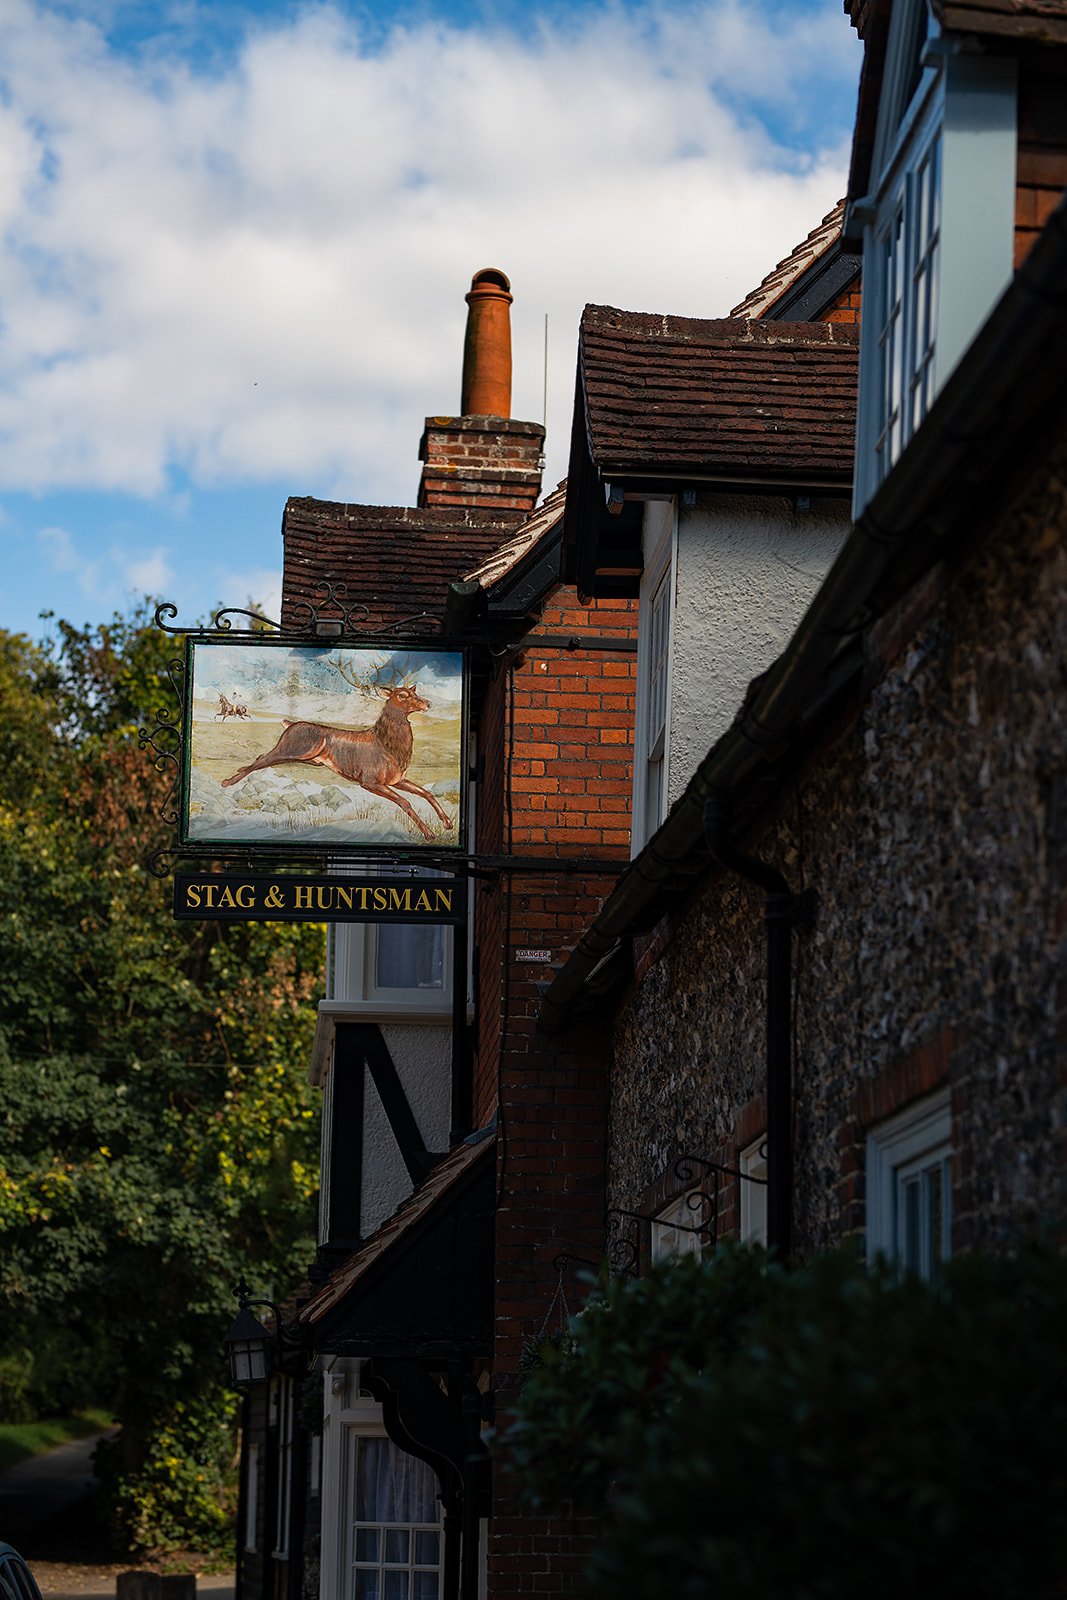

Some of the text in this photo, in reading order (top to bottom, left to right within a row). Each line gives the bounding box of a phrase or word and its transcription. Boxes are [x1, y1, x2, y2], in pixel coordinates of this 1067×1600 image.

[186, 884, 453, 912] STAG & HUNTSMAN
[519, 950, 548, 958] DANGER
